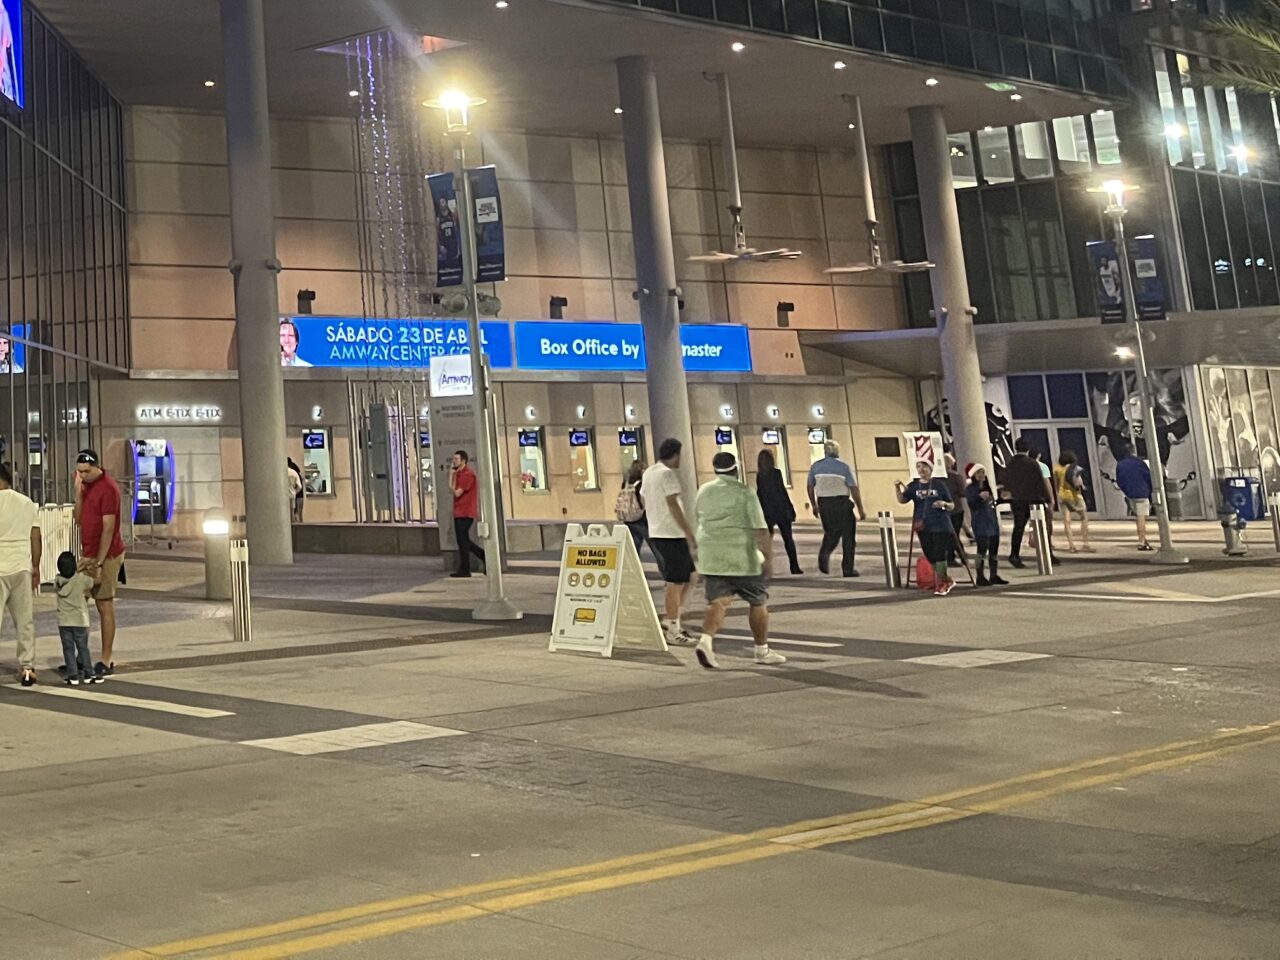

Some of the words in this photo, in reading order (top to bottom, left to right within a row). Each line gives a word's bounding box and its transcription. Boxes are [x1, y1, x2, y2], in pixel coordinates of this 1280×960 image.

[326, 322, 393, 344] SÁBADO
[399, 326, 420, 344] 23
[423, 328, 443, 344] DE
[447, 328, 488, 344] ABL
[540, 338, 568, 356] Box
[572, 338, 619, 356] Office
[622, 339, 640, 359] by
[442, 373, 472, 386] Amway
[140, 408, 161, 418] ATM
[167, 408, 191, 418] E-TIX
[196, 408, 220, 418] E-TIX
[588, 550, 607, 558] BAGS
[576, 558, 607, 567] ALLOWED
